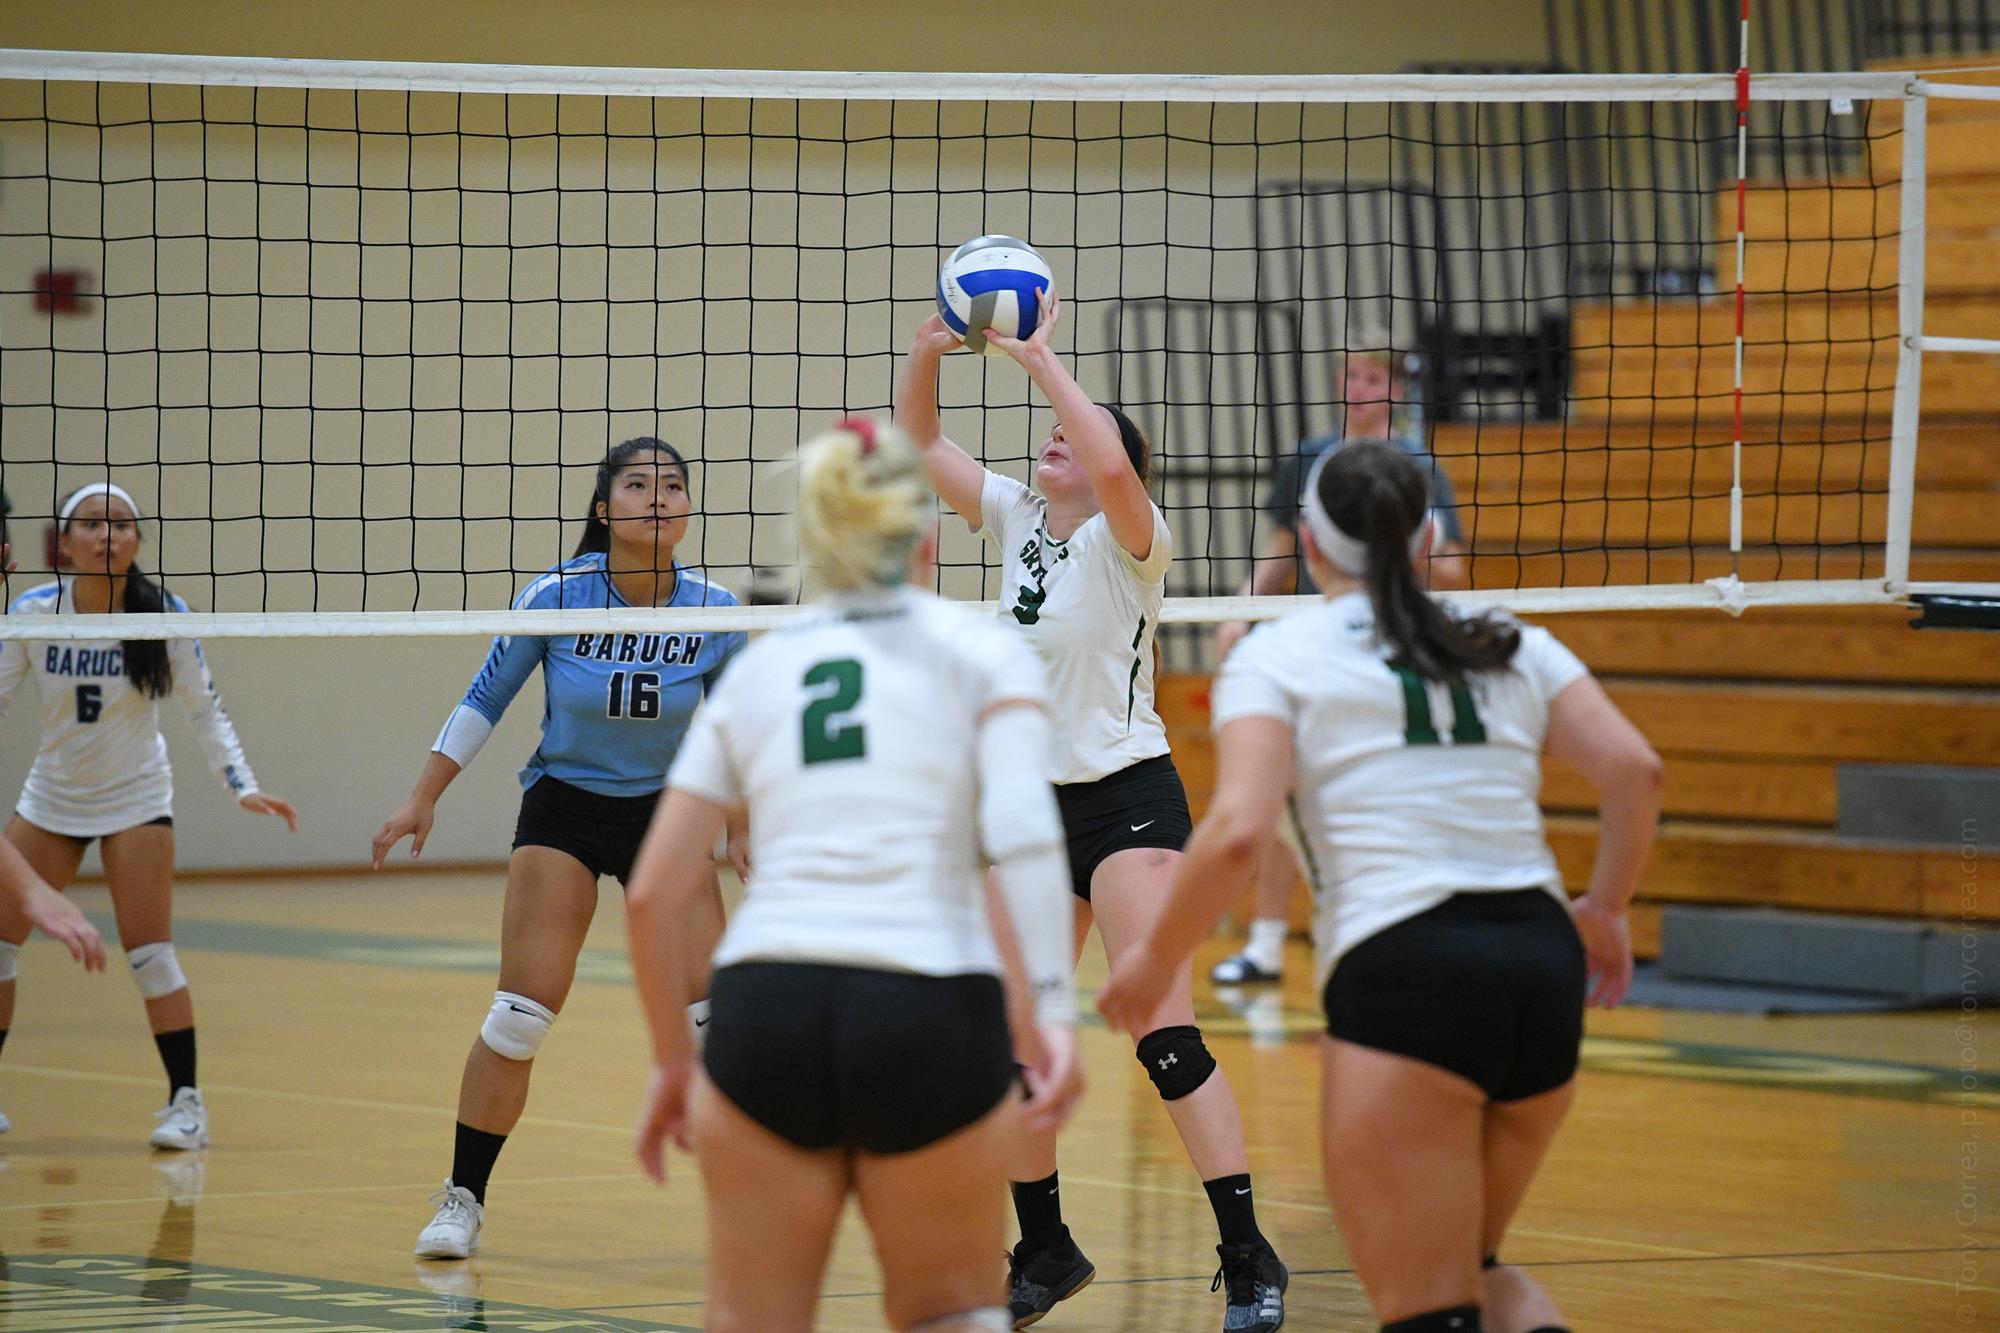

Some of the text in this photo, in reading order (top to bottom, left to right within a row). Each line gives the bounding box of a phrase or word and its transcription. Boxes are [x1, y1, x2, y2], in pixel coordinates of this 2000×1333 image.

[573, 632, 704, 667] BARUCH
[76, 684, 102, 723] 6
[607, 669, 661, 720] 16
[802, 658, 864, 764] 2
[1384, 659, 1486, 744] 11
